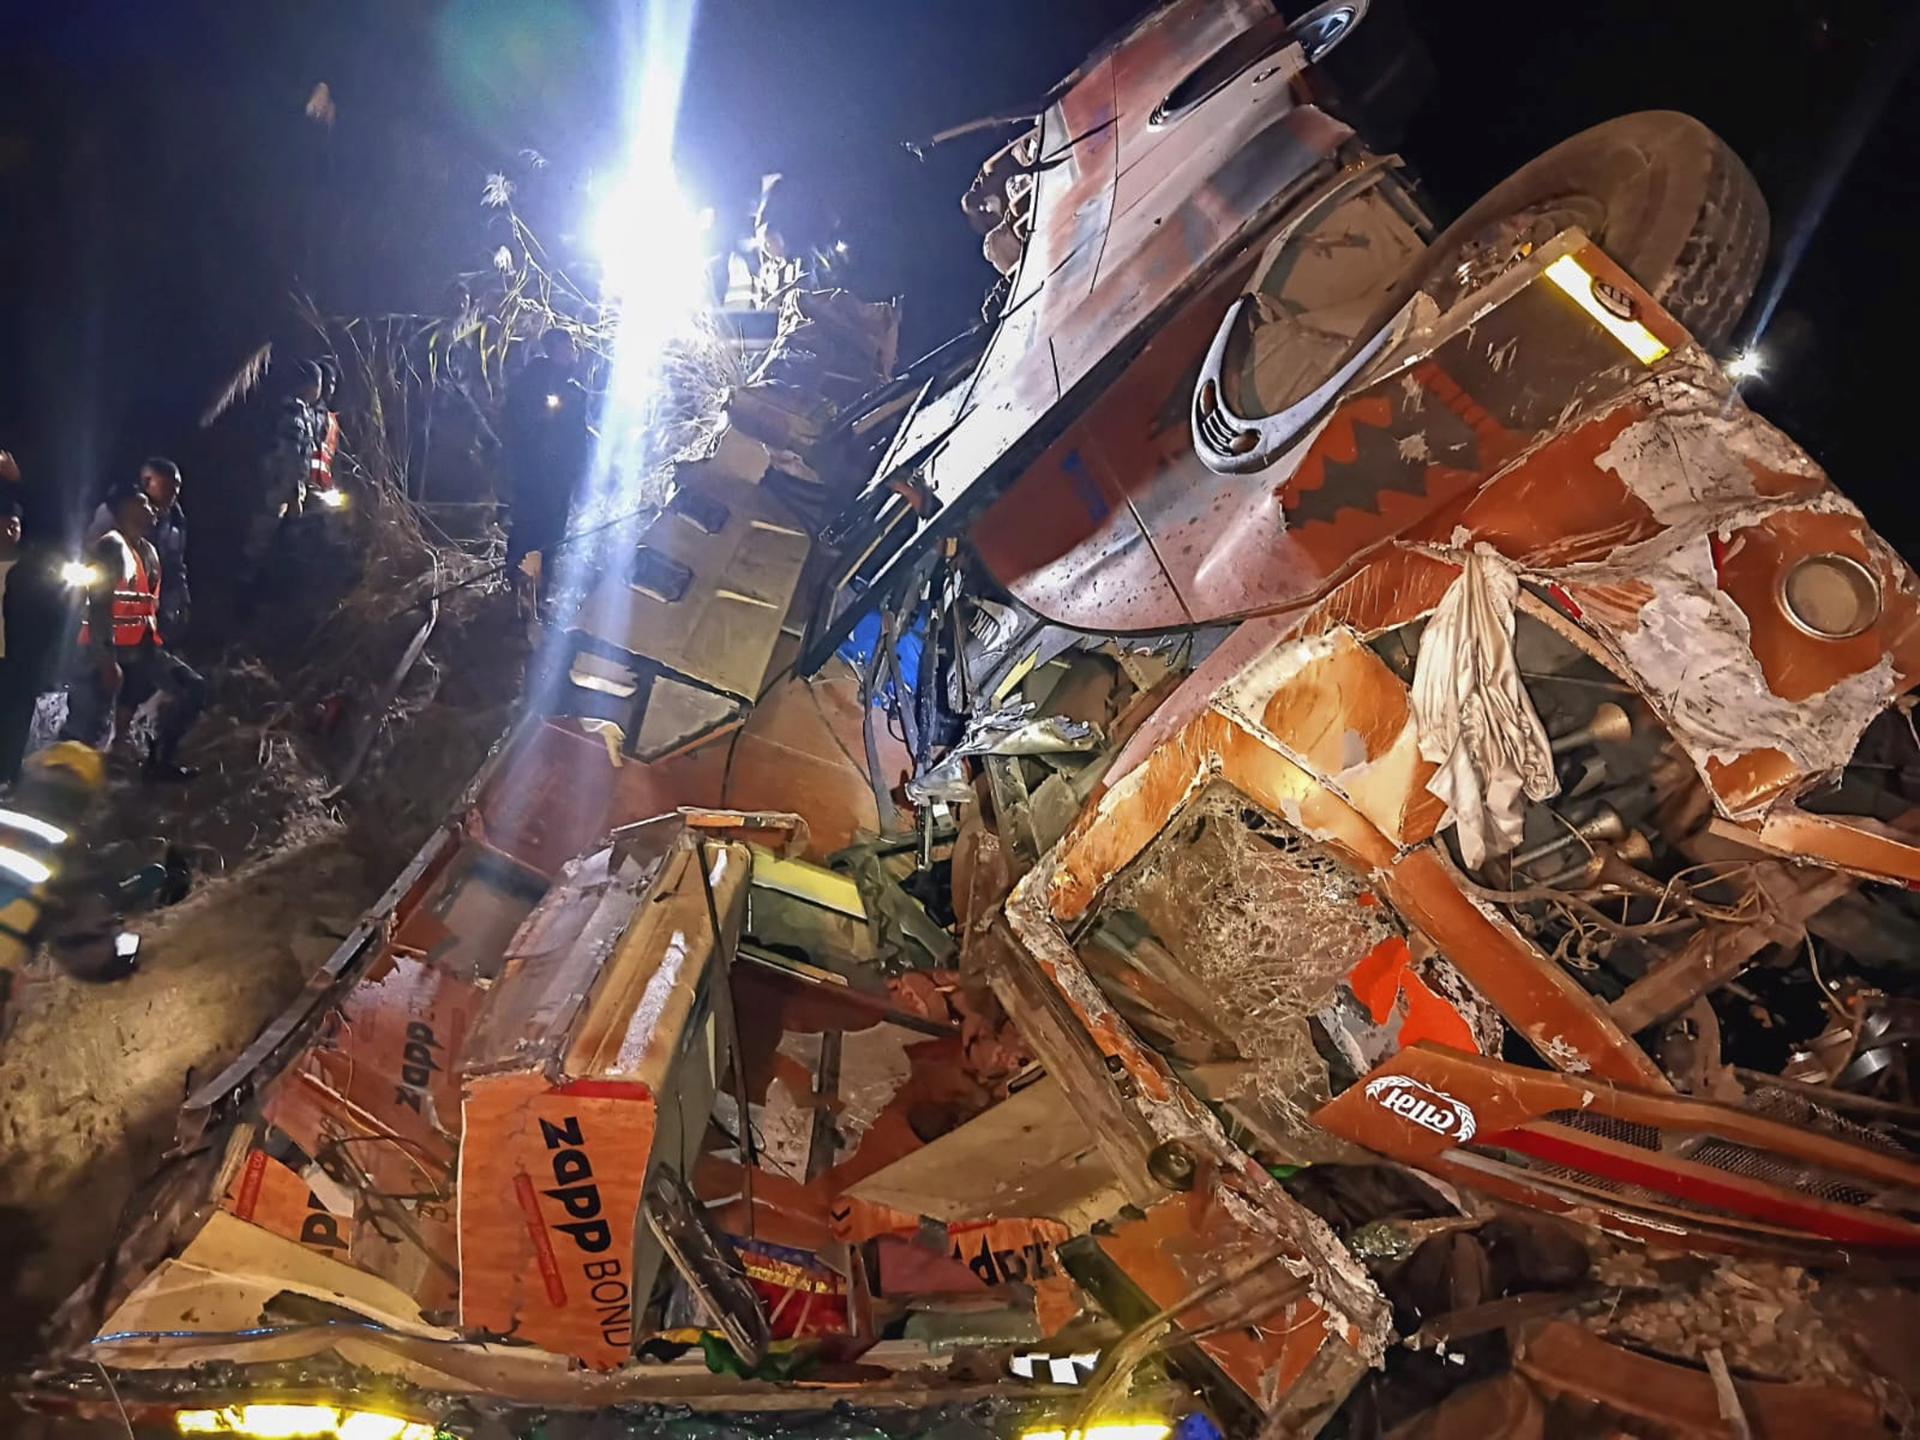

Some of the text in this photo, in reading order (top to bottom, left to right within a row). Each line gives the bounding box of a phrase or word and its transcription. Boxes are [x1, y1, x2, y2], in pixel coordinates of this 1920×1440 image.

[394, 1021, 445, 1115] zapp
[538, 1115, 612, 1253] zapp
[952, 1233, 1057, 1288] zap
